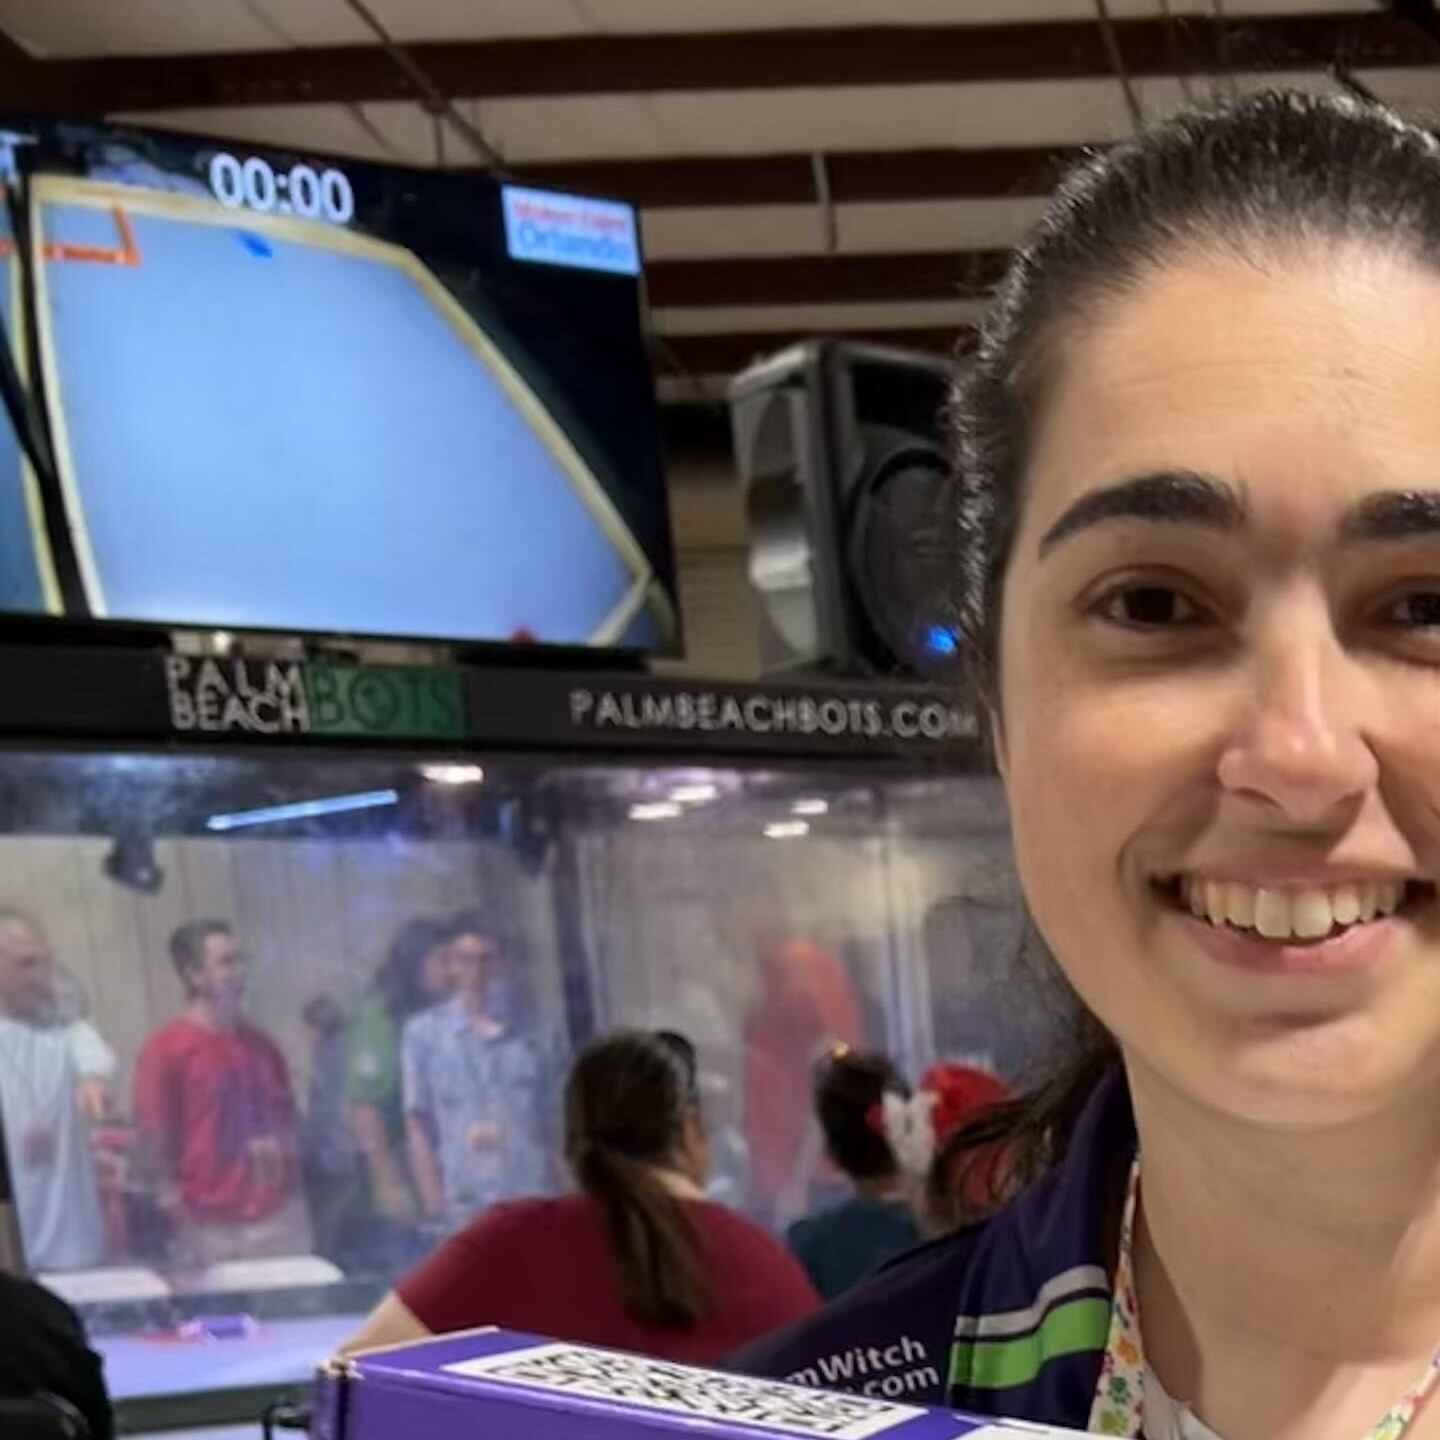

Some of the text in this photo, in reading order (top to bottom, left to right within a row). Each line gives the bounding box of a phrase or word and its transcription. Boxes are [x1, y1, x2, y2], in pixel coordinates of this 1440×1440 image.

[209, 153, 353, 222] 00:00
[165, 655, 304, 699] PALM
[170, 664, 460, 733] BEACH BOTS
